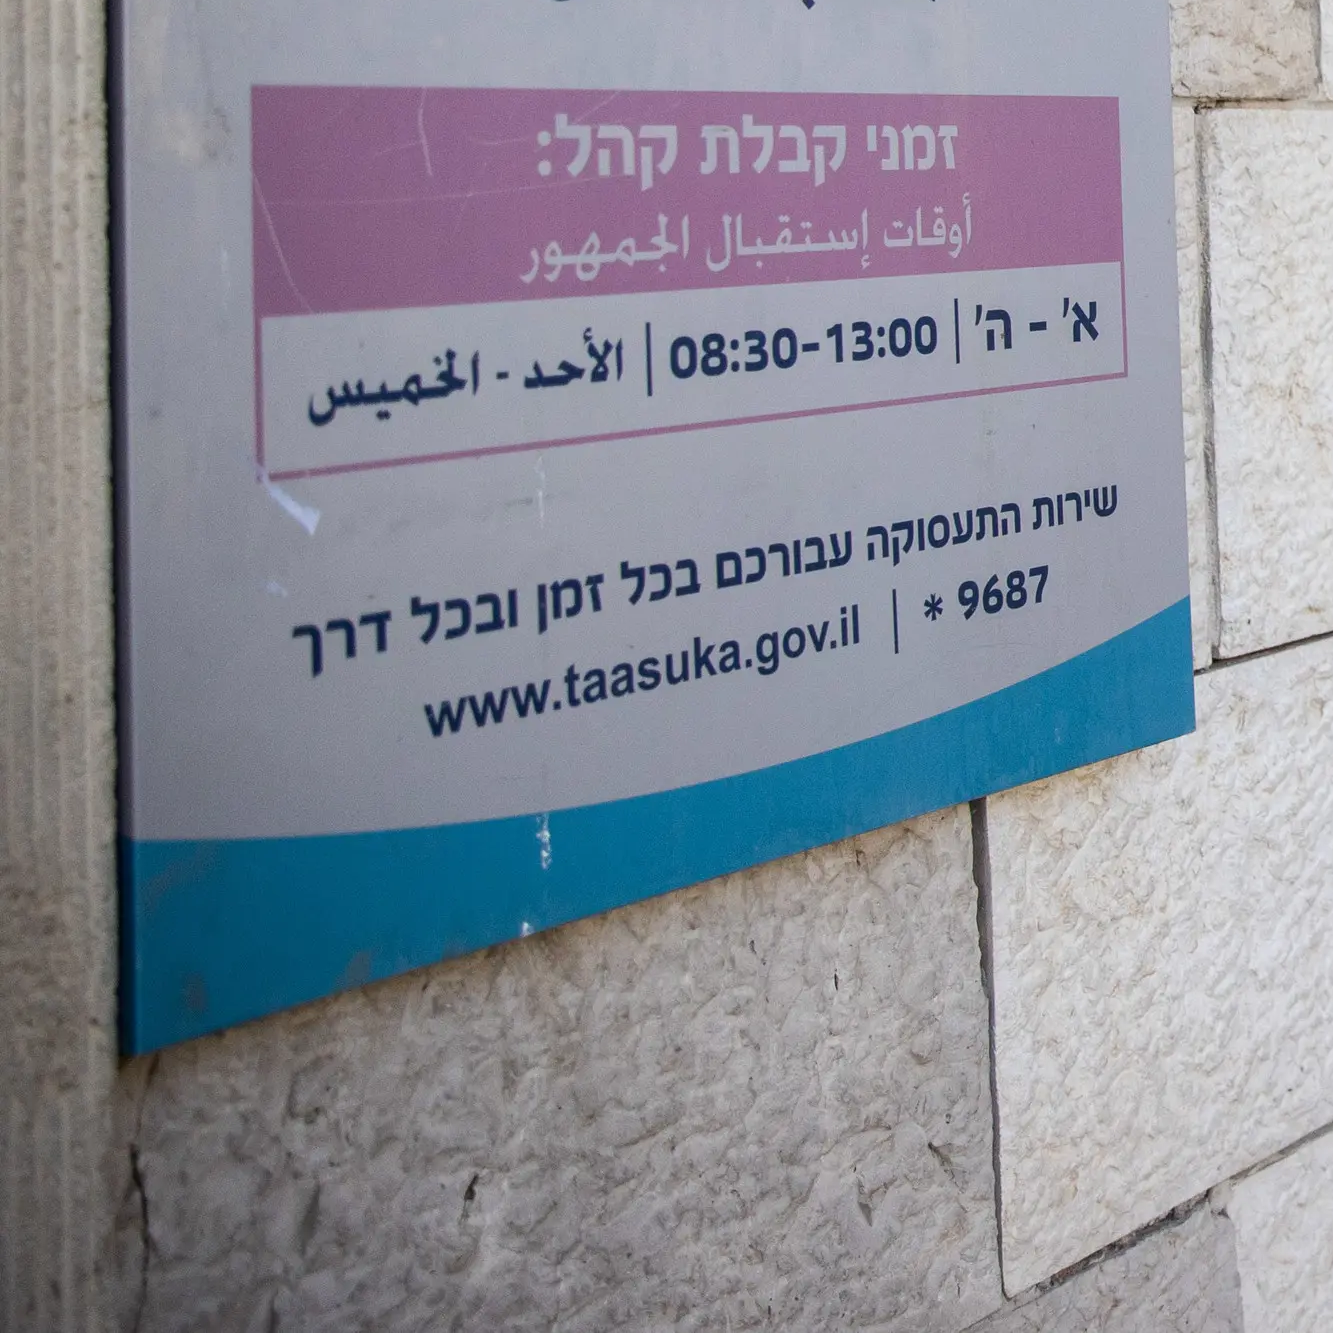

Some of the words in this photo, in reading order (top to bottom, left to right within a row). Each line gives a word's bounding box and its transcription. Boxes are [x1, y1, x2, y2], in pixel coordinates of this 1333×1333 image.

[538, 114, 677, 189] קהל:
[701, 114, 846, 185] קבלת
[867, 125, 958, 170] זמני
[520, 215, 688, 281] الجمهور
[707, 208, 870, 271] إستقبال
[884, 192, 971, 257] أوقات
[307, 348, 480, 427] الخميس
[523, 327, 623, 390] الأحد
[866, 502, 1022, 567] התעסוקה
[1032, 484, 1118, 531] שירות
[619, 558, 701, 606] בכל
[715, 530, 853, 590] עבורכם
[409, 588, 519, 645] ובכל
[537, 573, 605, 635] זמן
[291, 610, 393, 679] דרך
[423, 603, 860, 738] www.taasuka.gov.il
